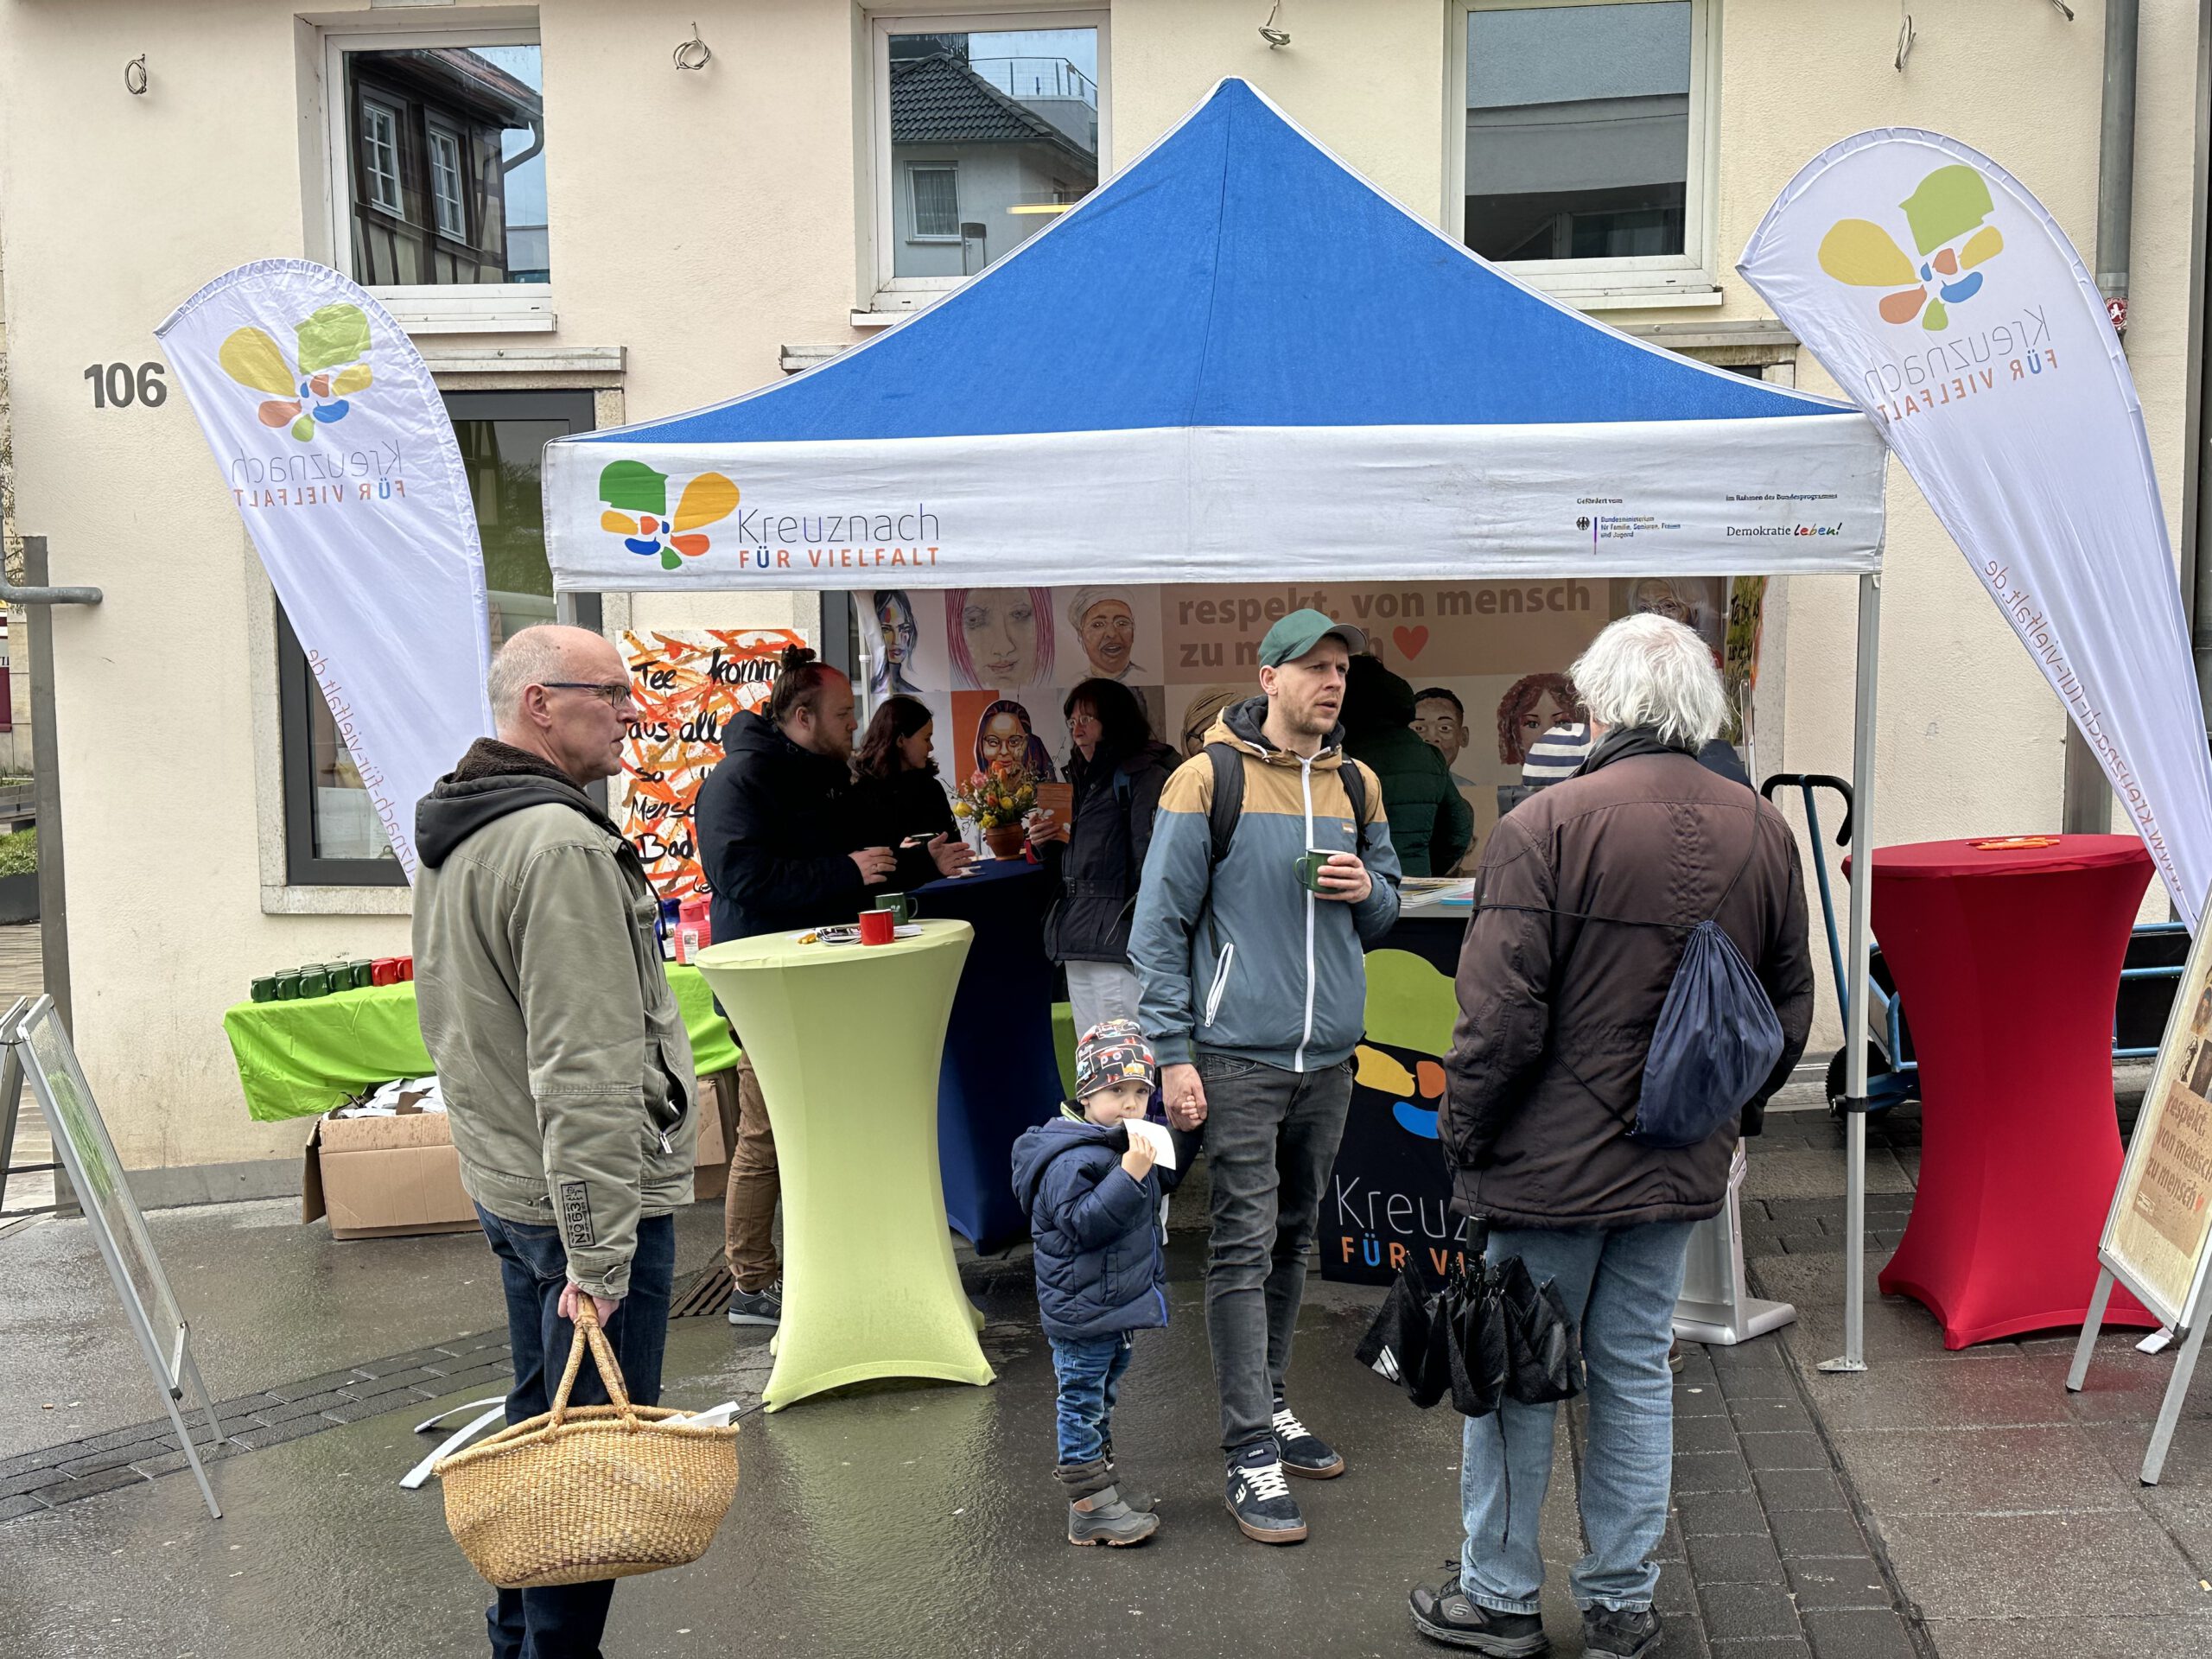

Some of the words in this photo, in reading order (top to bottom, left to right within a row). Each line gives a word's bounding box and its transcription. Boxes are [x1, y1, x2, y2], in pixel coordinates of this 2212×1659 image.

[84, 361, 168, 409] 106
[738, 502, 940, 544] Kreuznach
[1726, 524, 1792, 537] Demokratie
[740, 545, 791, 569] FÜR
[807, 547, 940, 569] VIELFALT
[1178, 587, 1339, 632] respekt.
[1351, 593, 1424, 619] von
[1437, 580, 1592, 616] mensch
[630, 660, 677, 690] Tee
[707, 649, 779, 685] komm
[1179, 641, 1224, 668] zu
[628, 721, 670, 743] aus
[679, 709, 723, 744] all
[630, 796, 696, 822] Mensc
[2157, 1125, 2176, 1154] von
[2145, 1156, 2160, 1182] zu
[2157, 1165, 2198, 1211] mensch
[1340, 1232, 1407, 1271] FÜR
